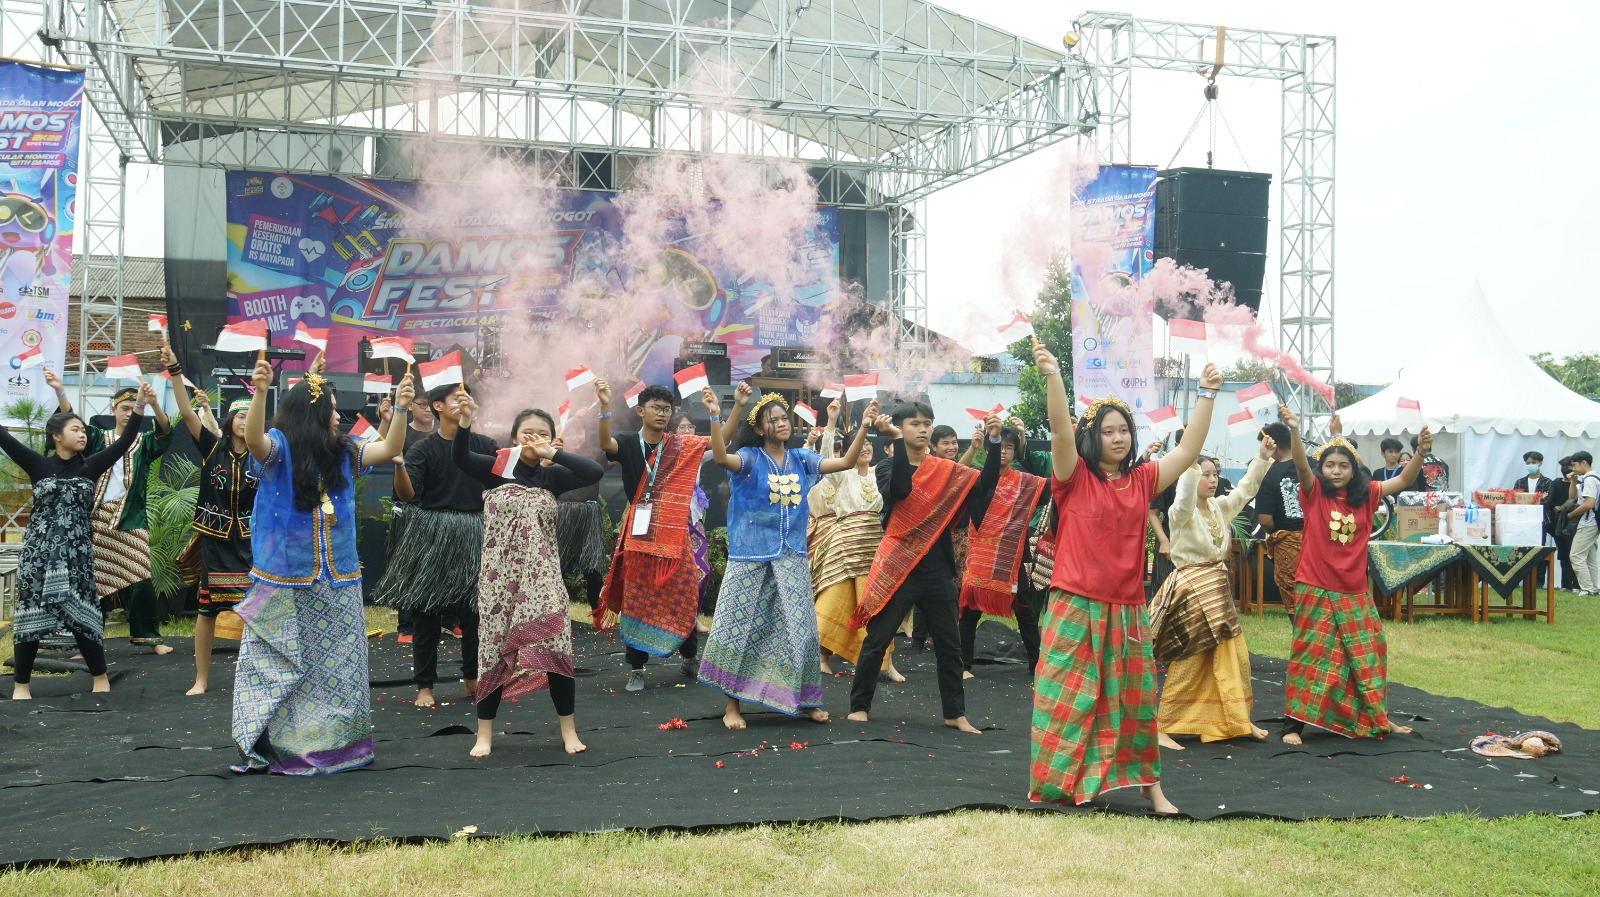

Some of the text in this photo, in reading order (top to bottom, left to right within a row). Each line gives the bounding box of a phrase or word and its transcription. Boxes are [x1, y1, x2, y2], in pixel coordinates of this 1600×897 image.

[373, 217, 411, 230] SMK
[538, 210, 597, 223] MOGOT
[254, 220, 301, 237] PEMERIKSAAN
[253, 229, 291, 245] KESEHATAN
[251, 239, 282, 254] GRATIS
[249, 250, 294, 267] RS MAYAPADA
[383, 236, 571, 276] DAMOS
[33, 286, 49, 297] TSM
[372, 276, 508, 311] FEST
[243, 295, 287, 317] BOOTH
[28, 309, 55, 320] ubm
[403, 314, 497, 330] SPECTACULAR
[1086, 358, 1107, 368] SGU
[1131, 378, 1147, 386] UPH
